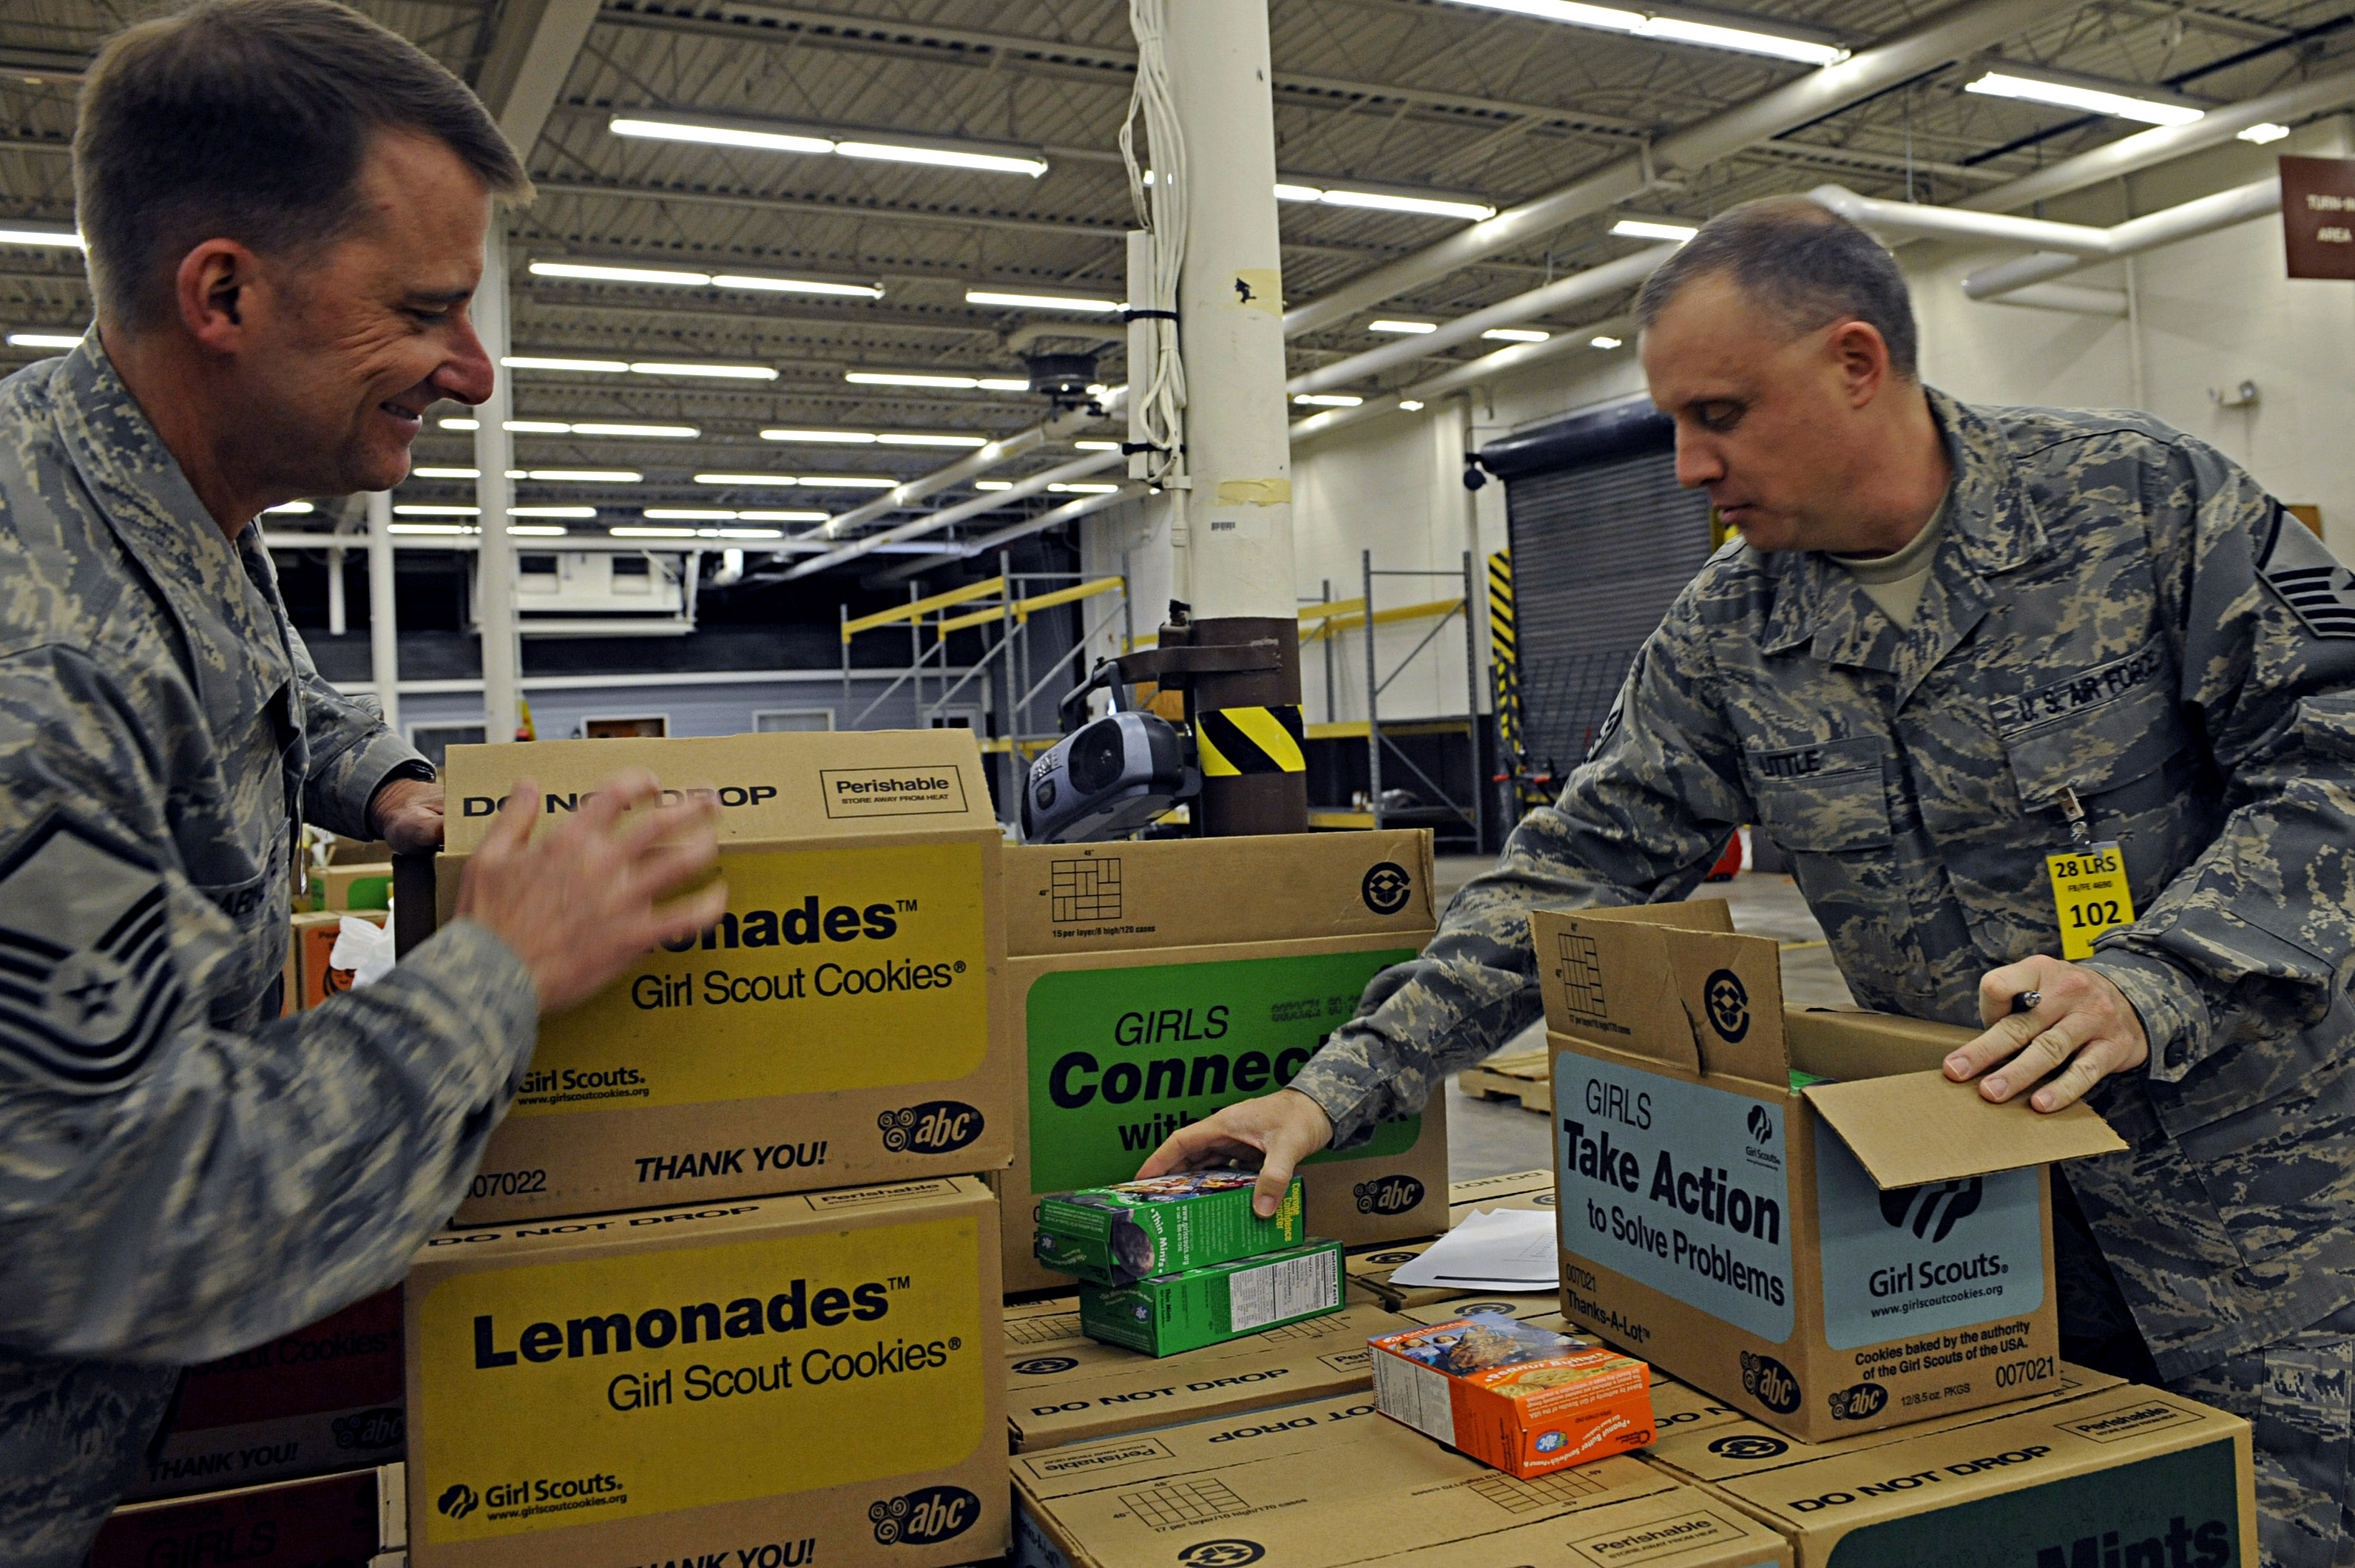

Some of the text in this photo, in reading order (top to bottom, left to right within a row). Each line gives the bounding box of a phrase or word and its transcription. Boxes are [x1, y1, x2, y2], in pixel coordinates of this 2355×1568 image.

[837, 777, 949, 794] Perishable
[2055, 856, 2117, 877] 28 LRS
[2070, 901, 2121, 927] 102
[1063, 930, 1075, 939] per
[632, 973, 692, 1010] Girl
[703, 967, 806, 1005] Scout
[1115, 1005, 1229, 1046] GIRLS
[518, 1069, 557, 1093] Girl
[518, 1087, 649, 1106] www.girlscoutcookies.org
[1586, 1078, 1652, 1130] GIRLS
[915, 1107, 970, 1147] abc
[635, 1140, 828, 1183] THANK YOU!
[467, 1169, 547, 1199] 07022
[822, 1183, 940, 1202] Perishable
[1378, 1180, 1415, 1210] abc
[1454, 1172, 1543, 1190] DO NOT
[1564, 1118, 1780, 1246] Take Action
[1291, 1183, 1300, 1215] Courage
[428, 1206, 760, 1247] DO NOT DROP
[1181, 1205, 1190, 1265] www.girlscouts.org
[1283, 1197, 1293, 1242] Confidence
[1151, 1211, 1169, 1268] Thin Mints
[1587, 1197, 1785, 1307] to Solve Problems
[1566, 1263, 1596, 1293] 007021
[1869, 1263, 1913, 1298] Girl
[1871, 1285, 2003, 1318] www.girlscoutcookies.org
[1855, 1321, 2031, 1366] Cookies baked by the authority
[1862, 1337, 2028, 1381] of the Girl Scouts of the USA.
[607, 1368, 672, 1412] Girl
[683, 1356, 793, 1402] Scout
[1759, 1367, 1792, 1406] abc
[1996, 1356, 2055, 1388] 007021
[1031, 1368, 1289, 1416] DO NOT DROP
[1850, 1388, 1880, 1415] abc
[1944, 1383, 1971, 1397] PKGS
[1209, 1405, 1376, 1443] OT DROP
[1605, 1421, 1627, 1437] Peanut
[2075, 1406, 2170, 1433] Perishable
[240, 1443, 299, 1468] YOU!
[1538, 1436, 1558, 1450] abc
[1552, 1447, 1581, 1466] Sandwich
[1582, 1433, 1602, 1450] Butter
[1045, 1448, 1157, 1472] Perishable
[485, 1481, 530, 1508] Girl
[1787, 1445, 2052, 1513] DO NOT DROP
[487, 1494, 627, 1521] www.girlscoutcookies.org
[908, 1494, 966, 1536] abc
[1170, 1521, 1187, 1530] per
[1279, 1498, 1308, 1508] cases
[146, 1520, 278, 1568] GIRLS
[1591, 1520, 1712, 1553] Perishable
[1668, 1535, 1695, 1544] FROM
[1695, 1528, 1720, 1538] HEAT
[737, 1538, 816, 1568] YOU!
